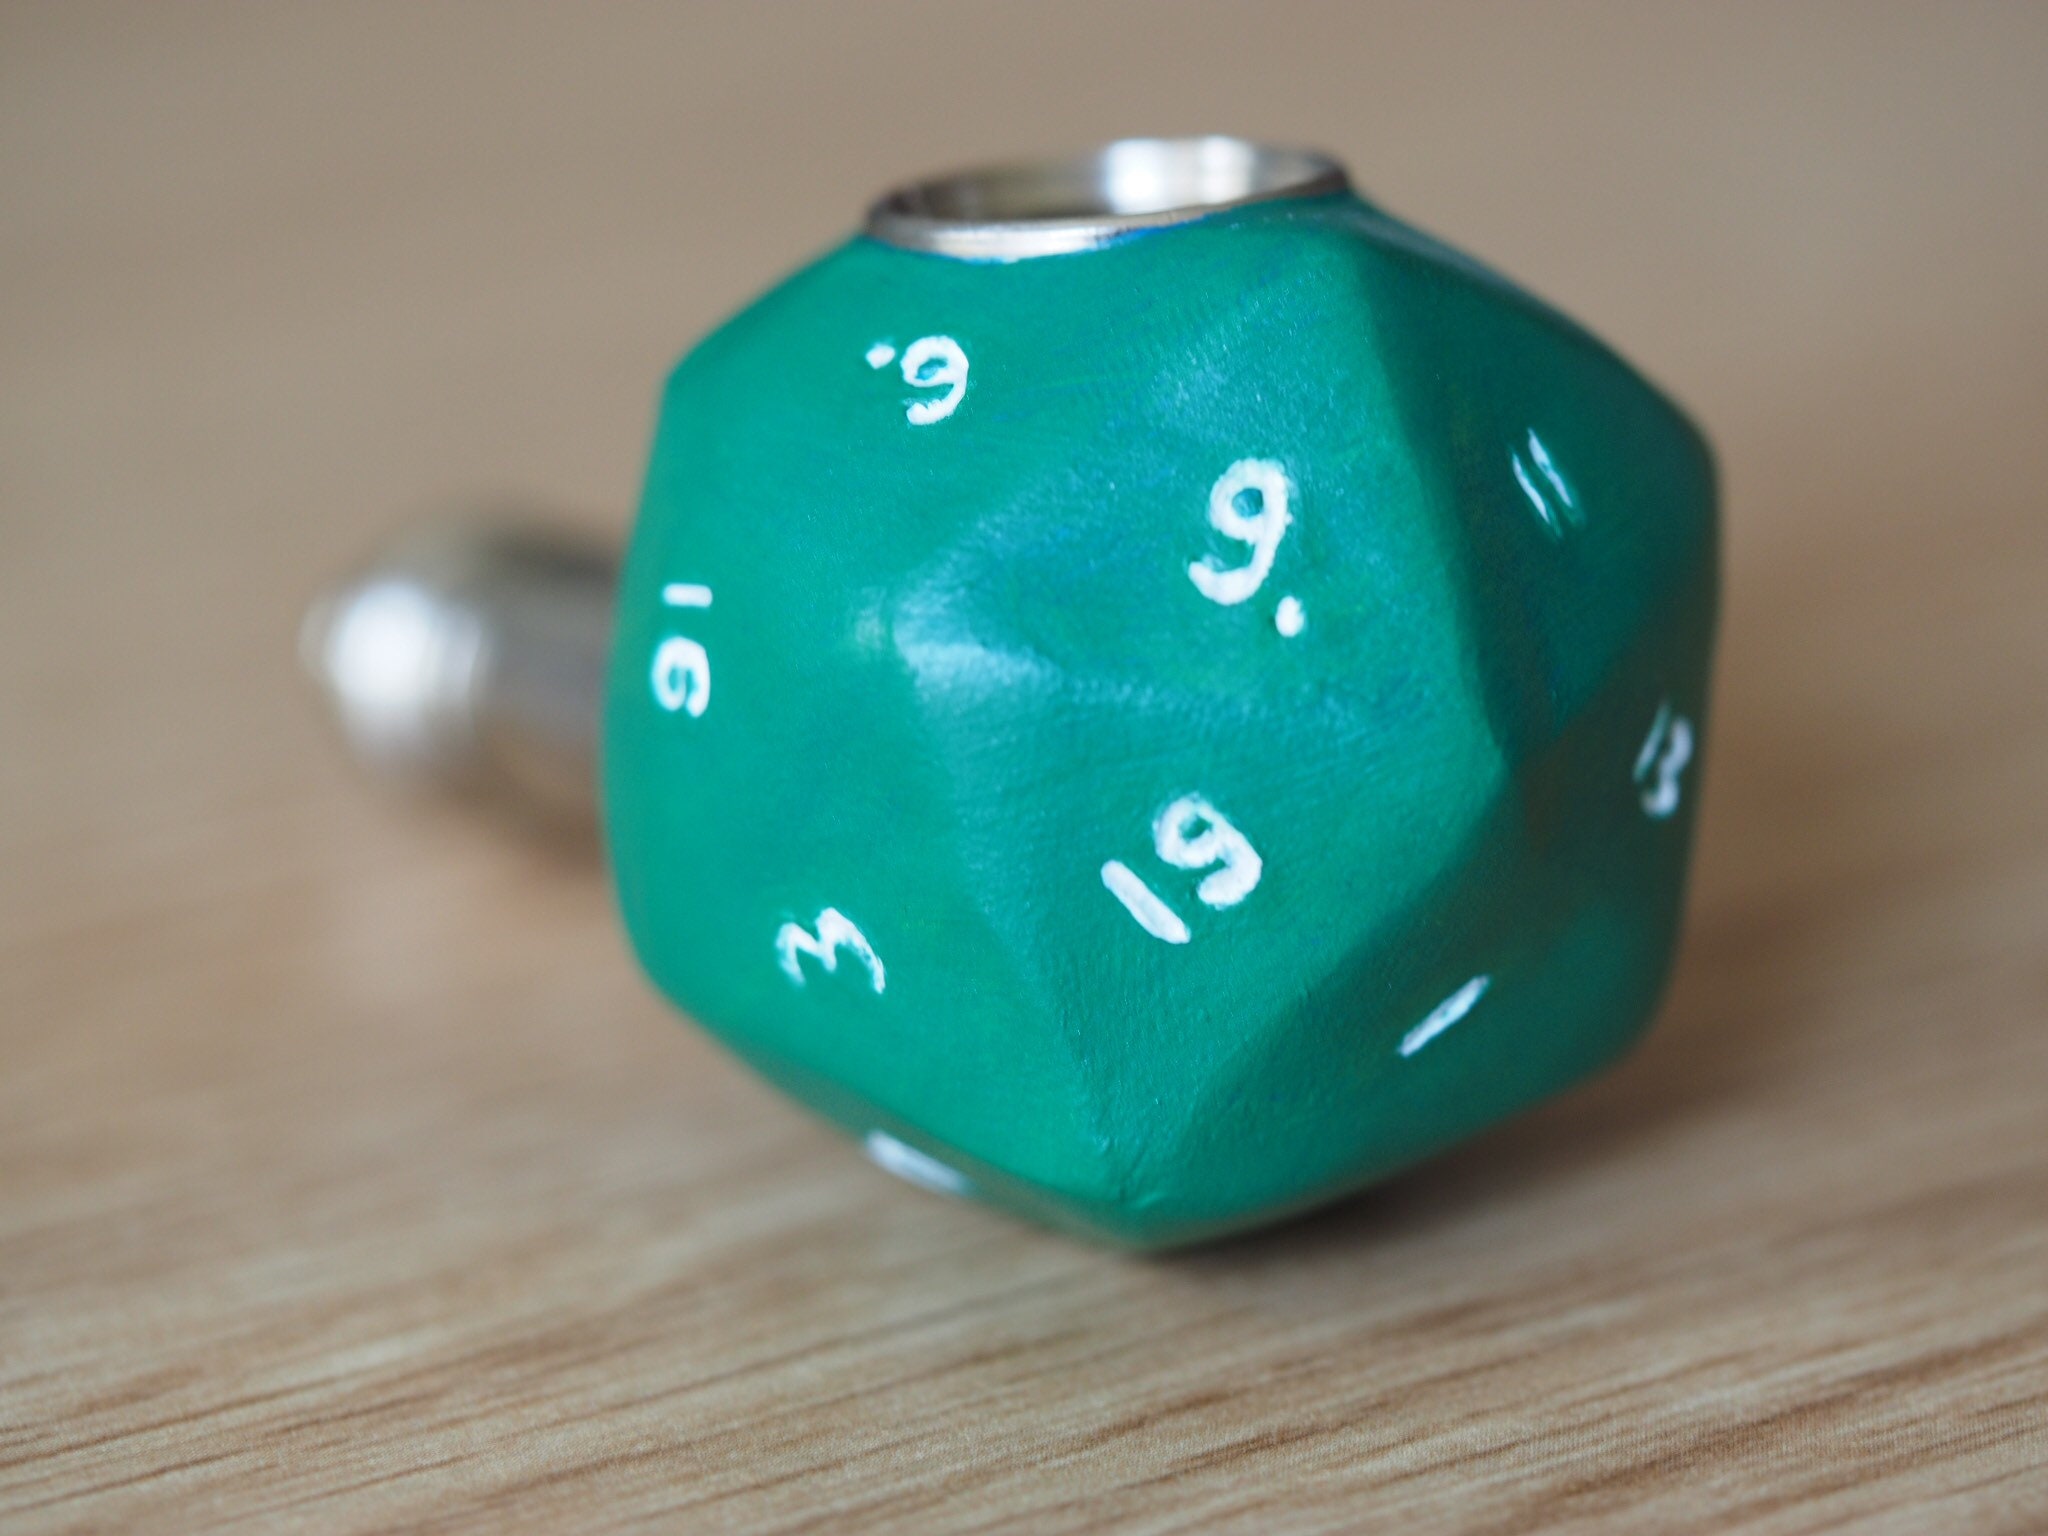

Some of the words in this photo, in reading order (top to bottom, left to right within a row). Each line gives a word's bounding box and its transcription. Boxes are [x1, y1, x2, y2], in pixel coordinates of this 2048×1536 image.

[652, 583, 713, 717] 16
[1101, 795, 1262, 943] 19
[776, 906, 886, 994] 3
